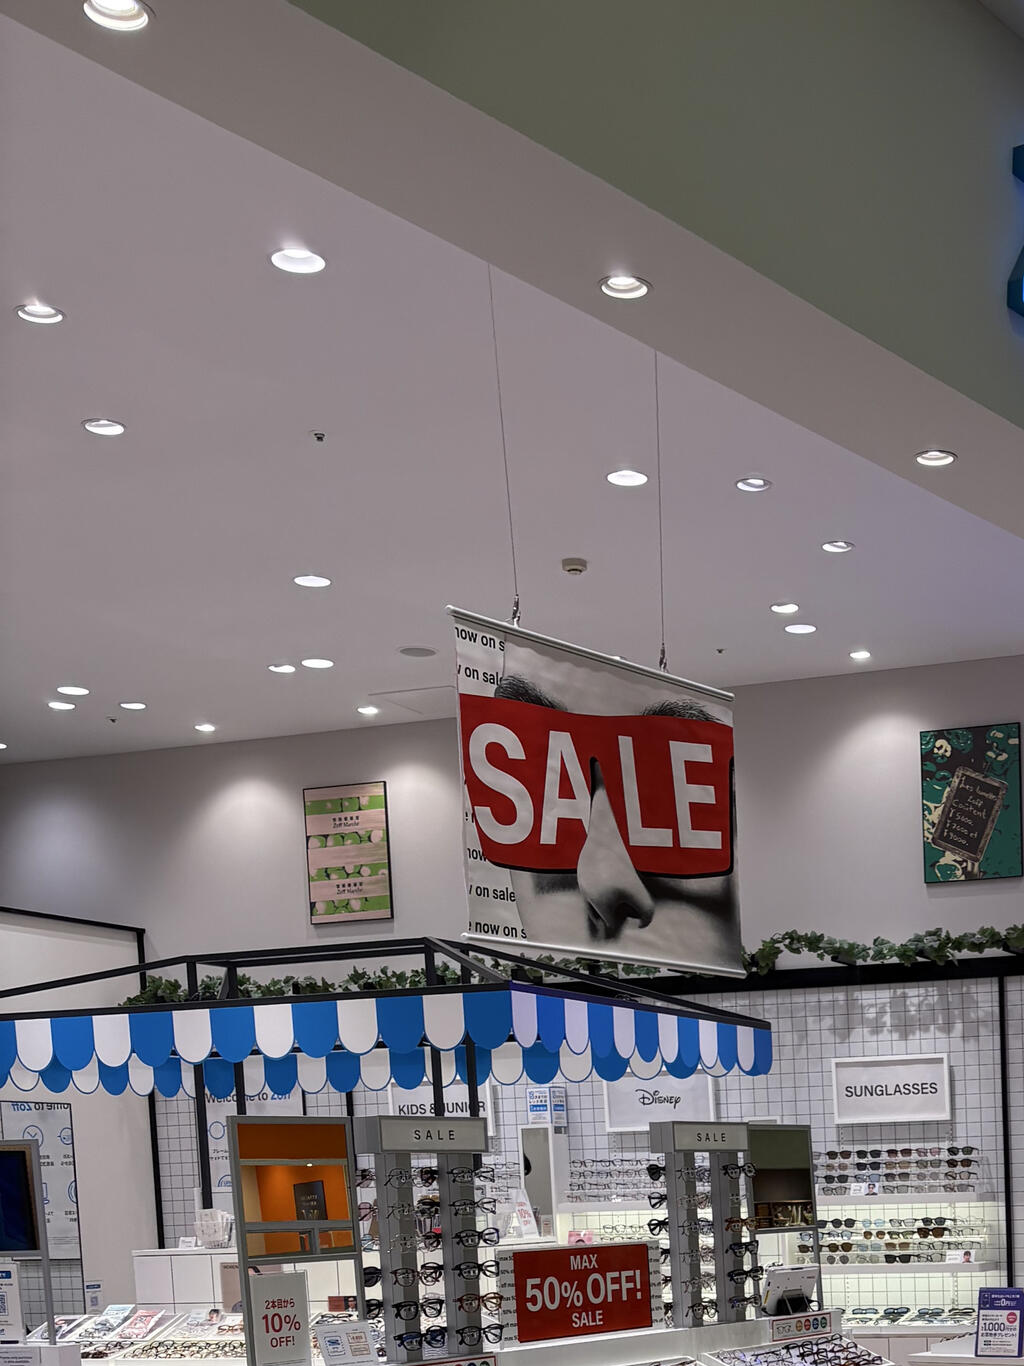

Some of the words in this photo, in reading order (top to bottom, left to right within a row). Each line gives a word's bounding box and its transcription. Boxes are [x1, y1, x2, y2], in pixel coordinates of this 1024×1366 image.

[481, 635, 496, 650] on
[464, 667, 480, 681] on
[468, 722, 724, 850] SALE
[475, 885, 490, 898] on
[492, 887, 516, 903] sale
[475, 920, 499, 935] now
[503, 924, 518, 939] on
[845, 1082, 938, 1098] SUNGLASSES
[398, 1103, 427, 1115] KIDS
[414, 1129, 456, 1141] SALE
[696, 1132, 726, 1142] SALE
[570, 1254, 599, 1270] MAX
[525, 1276, 584, 1312] 50%
[586, 1269, 642, 1305] OFF!
[264, 1298, 296, 1309] 2本目から
[262, 1312, 301, 1334] 10%
[572, 1310, 604, 1328] SALE
[270, 1336, 296, 1348] OFF!
